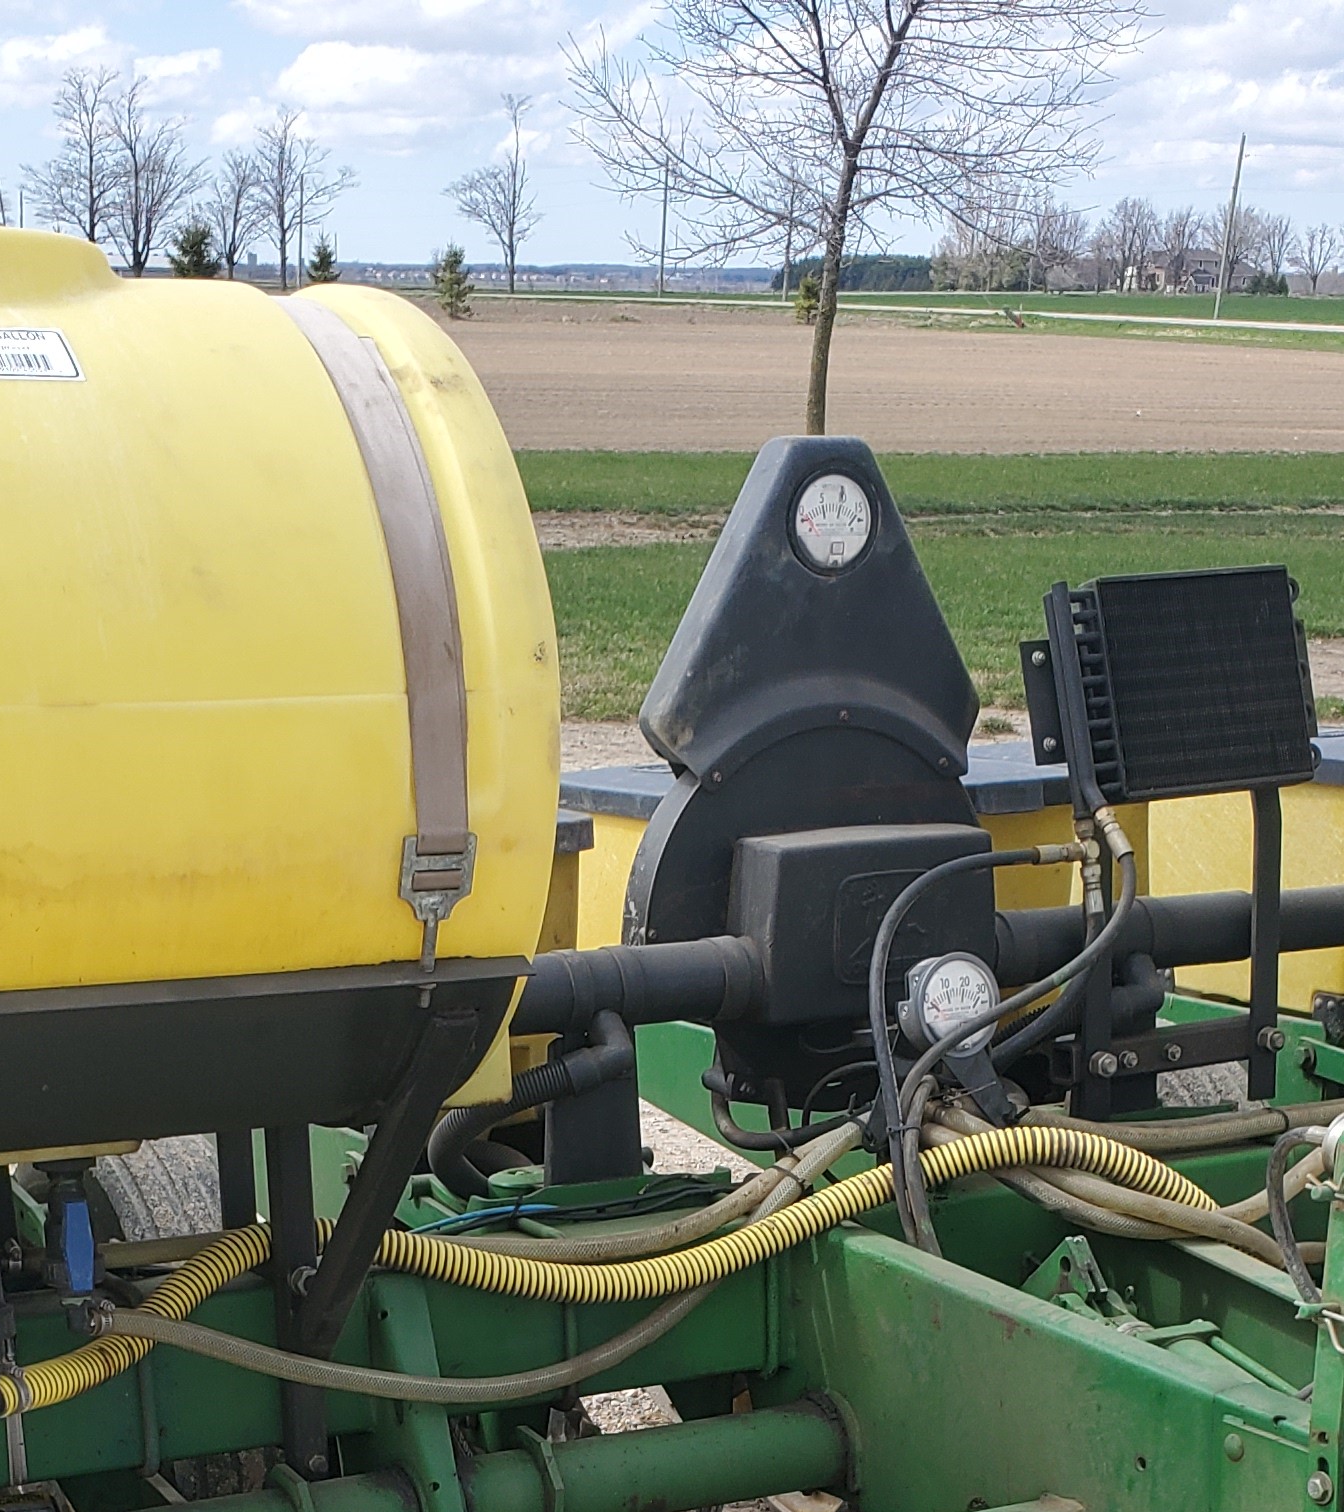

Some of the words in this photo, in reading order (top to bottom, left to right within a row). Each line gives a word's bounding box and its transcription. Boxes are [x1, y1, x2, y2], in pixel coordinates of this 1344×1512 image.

[819, 492, 825, 504] 5
[854, 502, 863, 513] 15
[940, 977, 950, 990] 10
[959, 975, 970, 988] 20
[976, 983, 986, 995] 30
